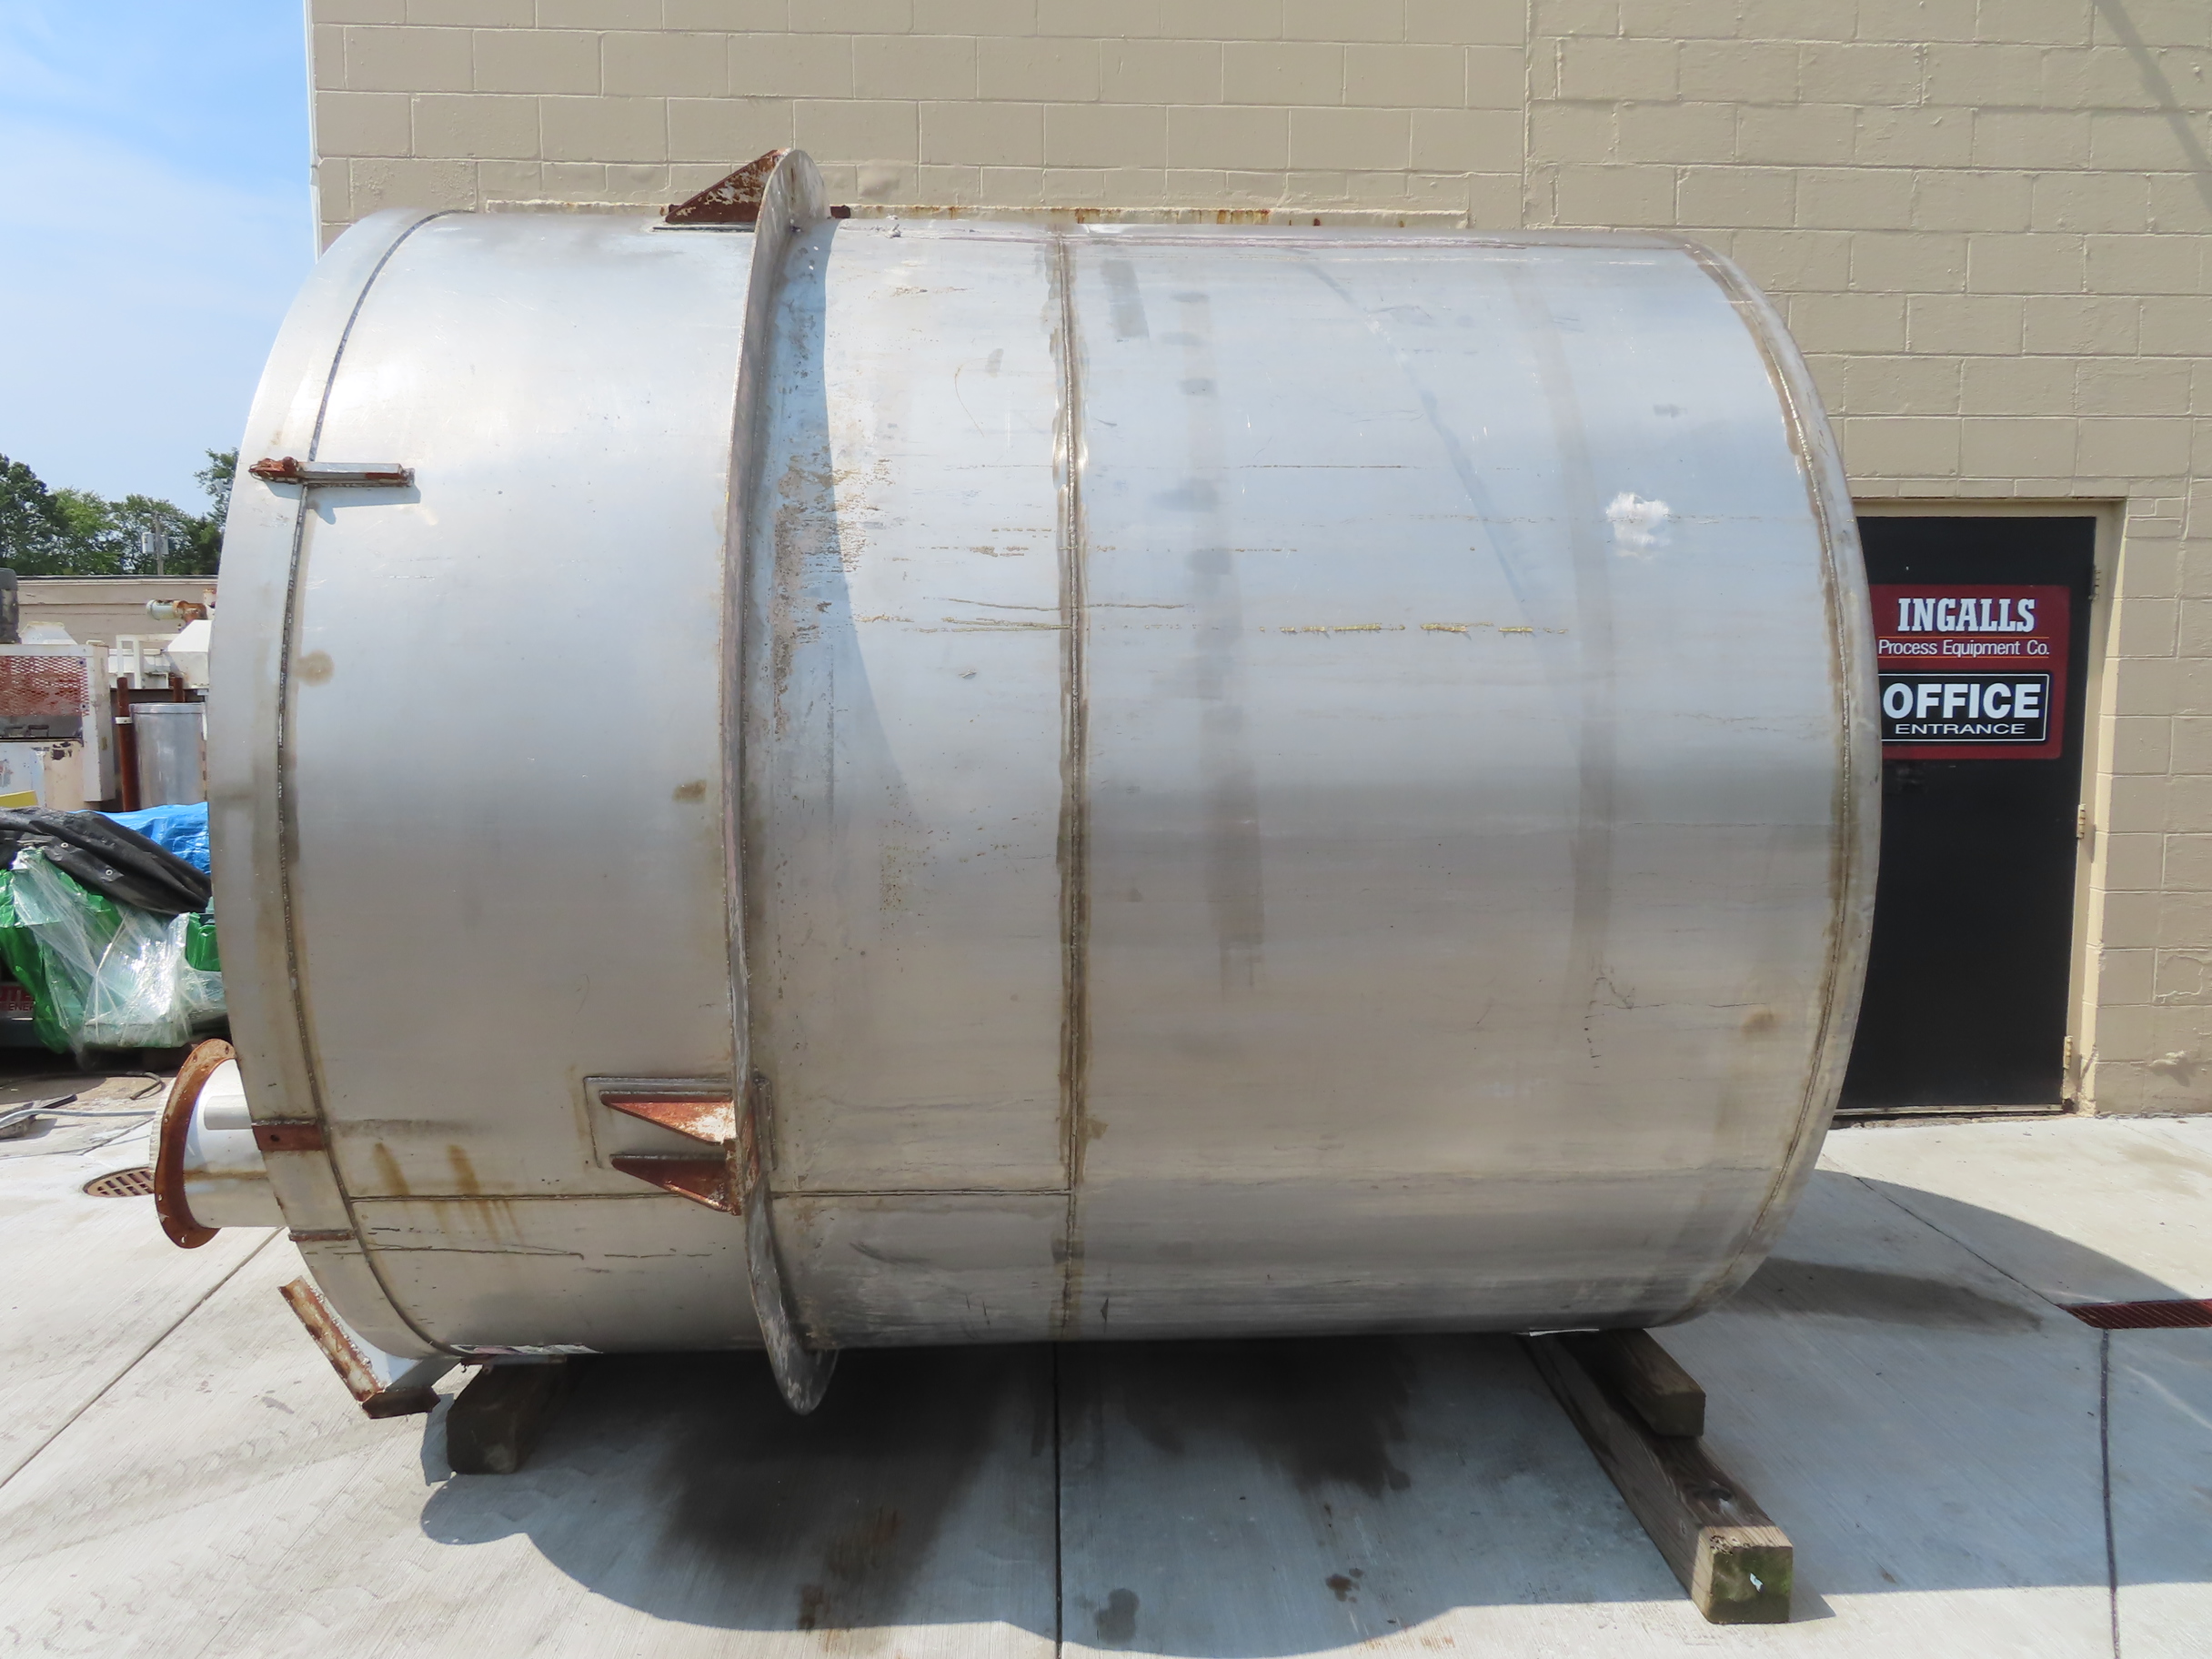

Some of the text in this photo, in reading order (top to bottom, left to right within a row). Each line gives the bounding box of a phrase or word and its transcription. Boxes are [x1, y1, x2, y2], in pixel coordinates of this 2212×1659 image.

[1897, 598, 2035, 632] INGALLS
[1878, 639, 2049, 658] Process Equipment Co.
[1883, 683, 2041, 719] OFFICE
[1895, 724, 2026, 734] ENTRANCE
